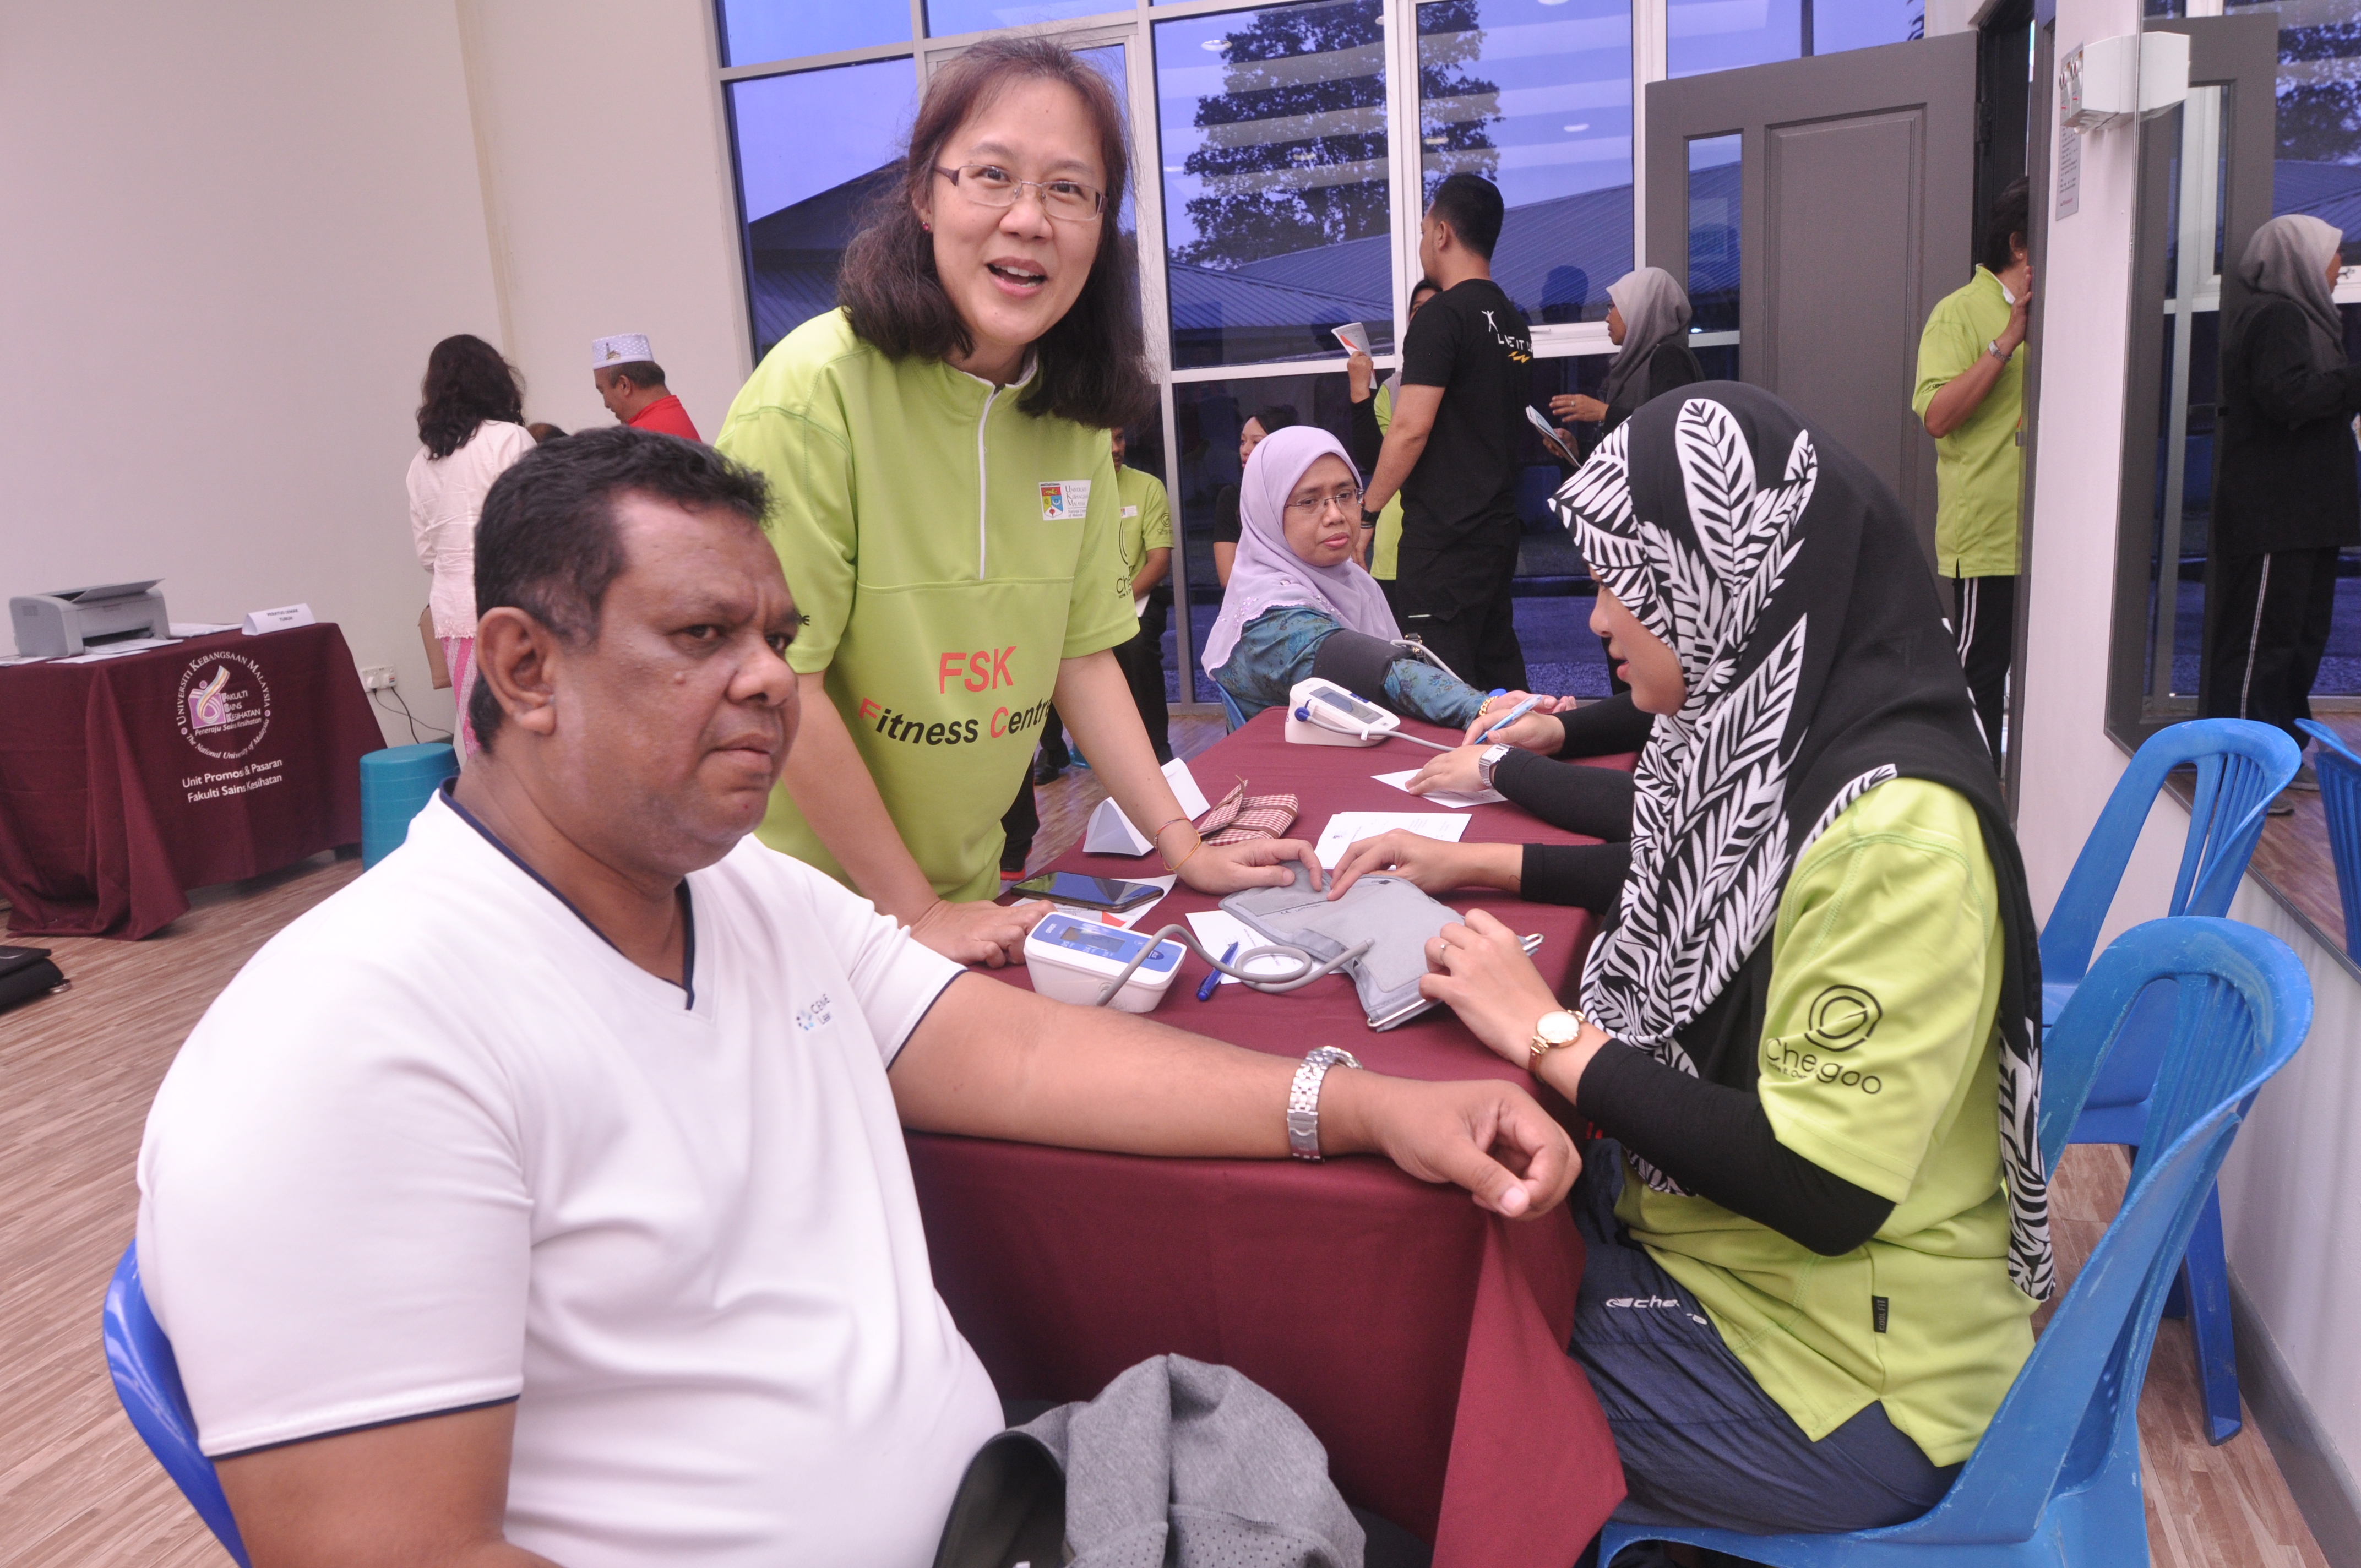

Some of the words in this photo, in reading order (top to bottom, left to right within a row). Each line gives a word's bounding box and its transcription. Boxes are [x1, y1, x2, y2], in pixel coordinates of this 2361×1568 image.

[939, 645, 1017, 694] FSK
[176, 670, 193, 726] UNIVERSITI
[189, 651, 248, 672] KEBANGSAAN
[247, 659, 271, 708] MALAYSIA
[225, 708, 262, 723] KESIHATAN
[858, 697, 979, 746] Fitness
[194, 726, 221, 736] Peneraju
[195, 743, 221, 759] National
[182, 775, 203, 788] Unit
[204, 767, 245, 783] Promosi
[244, 765, 250, 776] &
[251, 759, 283, 774] Pasaran
[187, 787, 220, 803] Fakulti
[221, 785, 247, 796] Sains
[246, 775, 282, 791] Kesihatan
